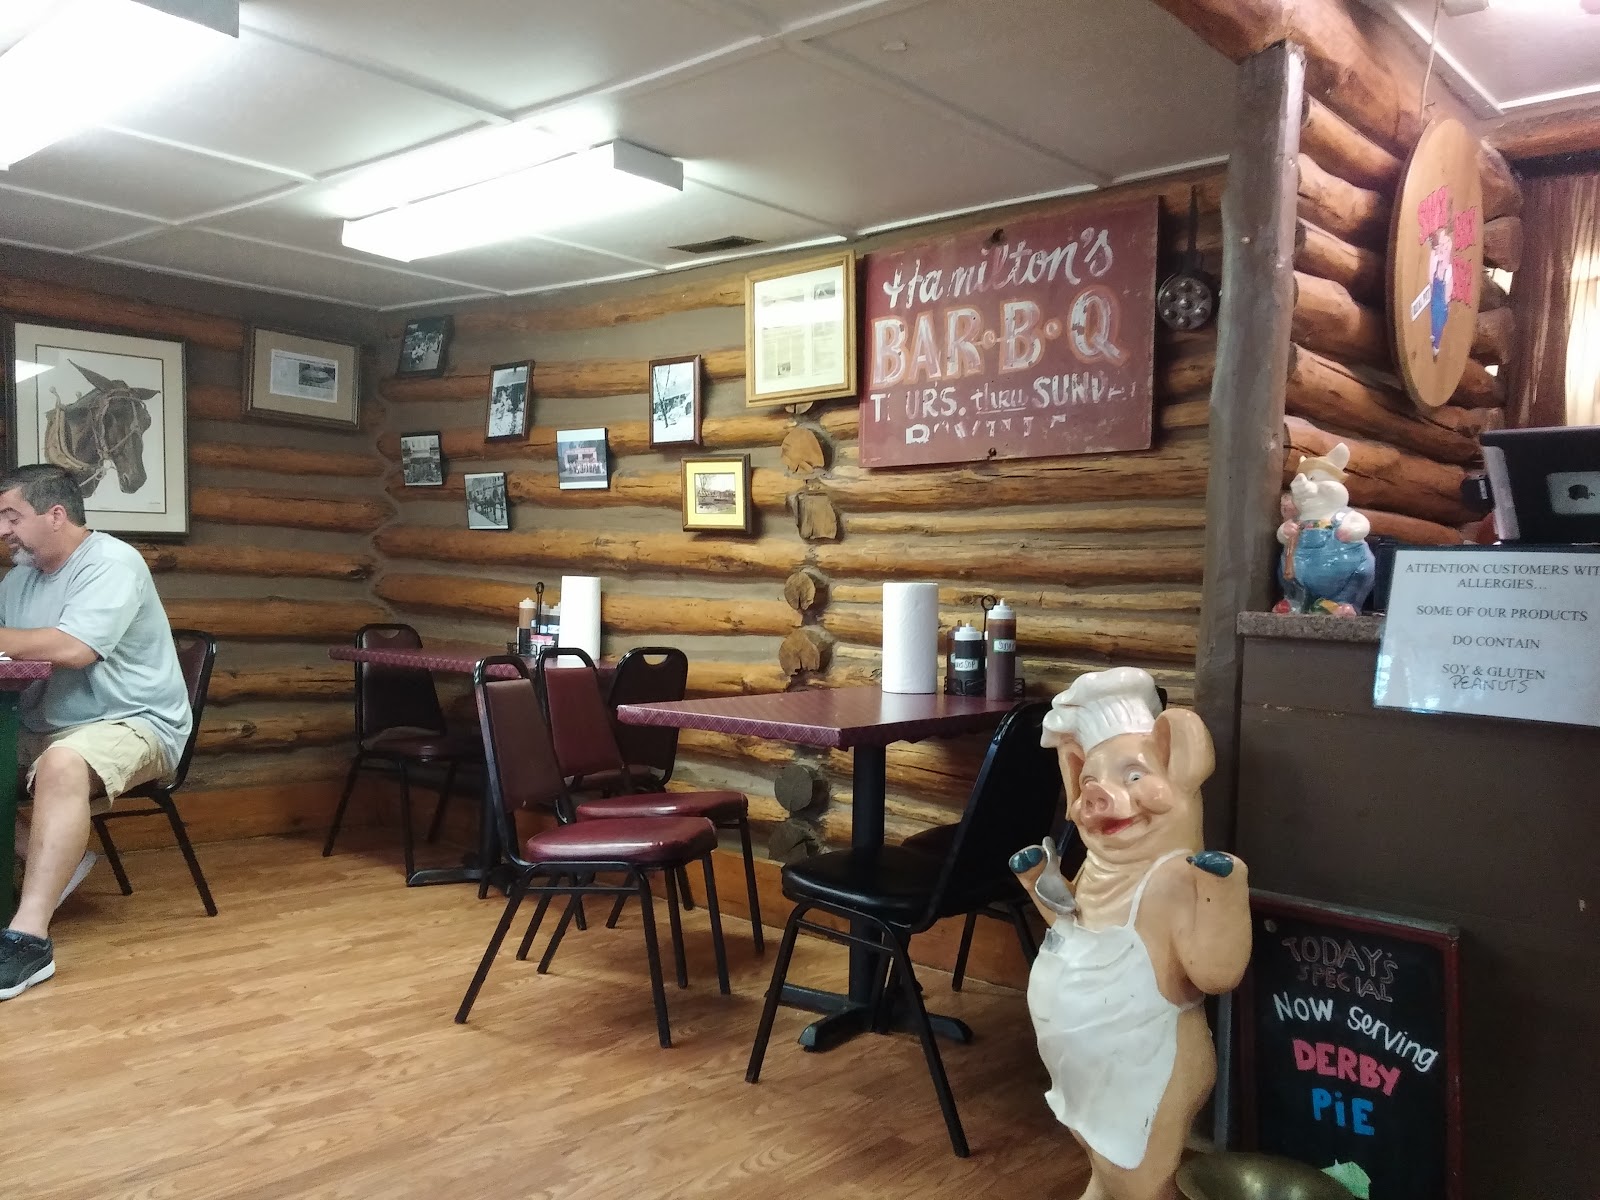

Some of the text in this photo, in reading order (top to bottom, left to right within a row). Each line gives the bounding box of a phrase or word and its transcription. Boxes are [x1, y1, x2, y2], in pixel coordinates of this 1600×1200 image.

[883, 226, 1114, 308] Hamilton's
[1405, 563, 1479, 574] ATTENTION
[1483, 563, 1569, 576] CUSTOMERS
[1416, 605, 1588, 622] SOME OF OUR PRODUCTS
[1452, 635, 1540, 649] DO CONTAIN
[1442, 663, 1546, 680] SOY & GLUTEN
[1449, 674, 1529, 693] PEANUTS
[1298, 965, 1393, 1003] SPECIAL
[1273, 991, 1334, 1022] NOW
[1292, 1037, 1402, 1097] DERBY
